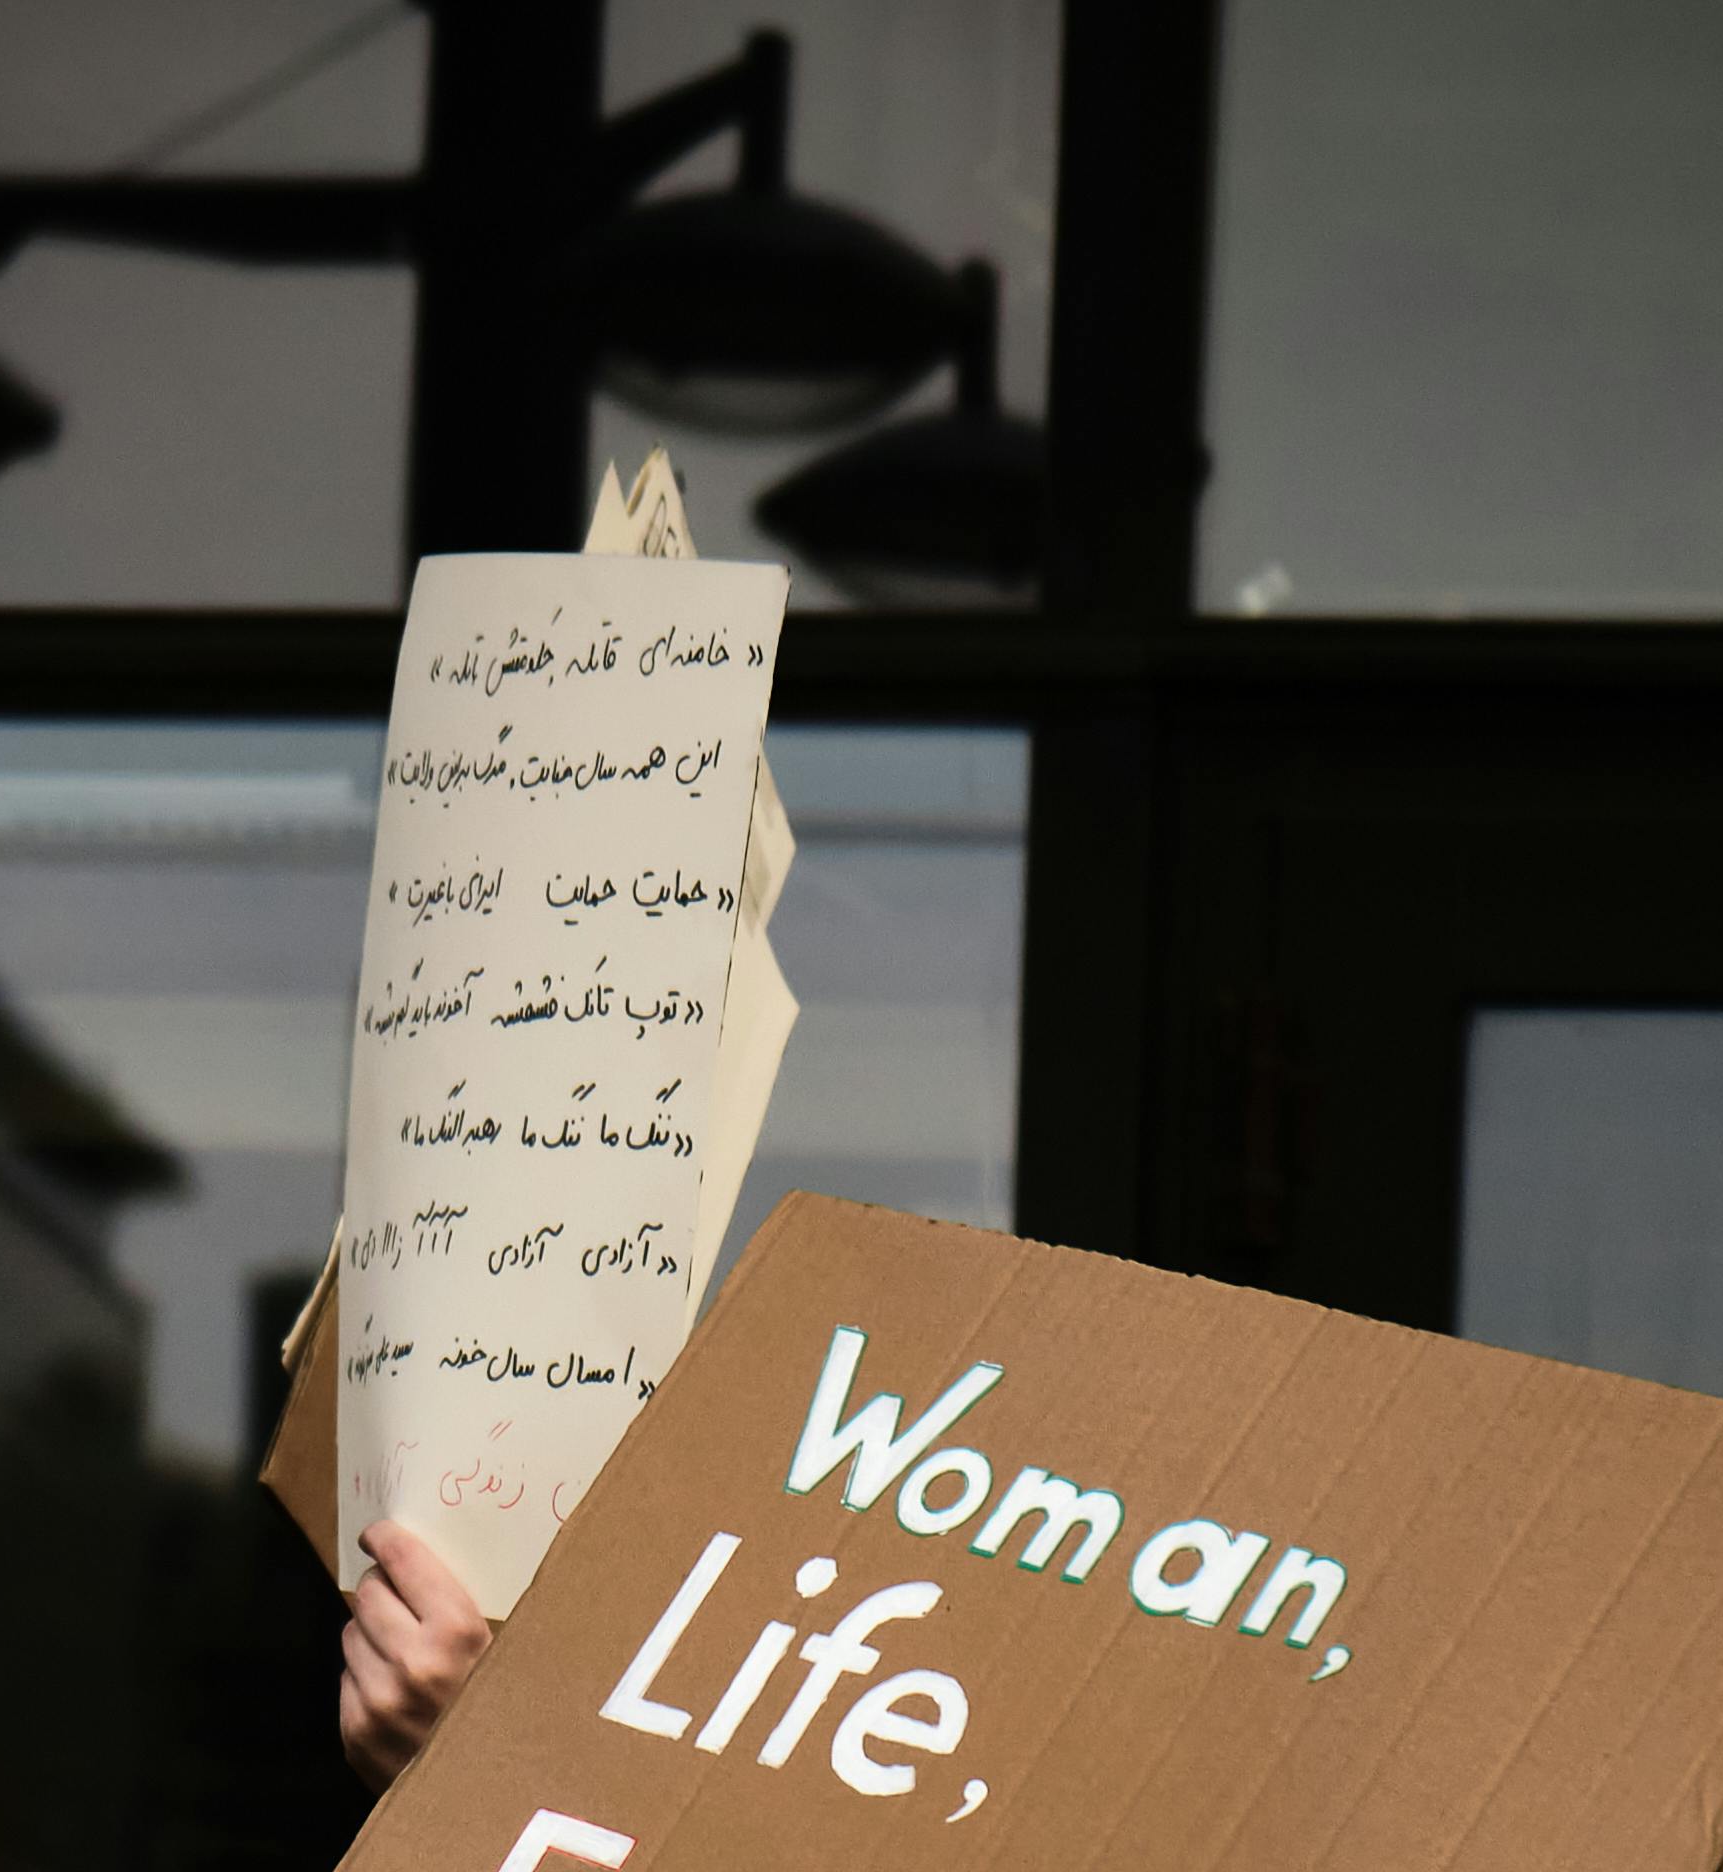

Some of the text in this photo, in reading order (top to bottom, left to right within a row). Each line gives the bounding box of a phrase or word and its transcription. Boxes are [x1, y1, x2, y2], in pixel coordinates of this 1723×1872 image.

[575, 751, 618, 791] سال
[620, 746, 667, 780] همه
[675, 739, 722, 799] این
[545, 873, 618, 927] حمایت
[489, 974, 565, 1029] فشفشه
[564, 955, 615, 1023] تانک
[461, 1116, 503, 1157] رهبر
[521, 1114, 537, 1149] ما
[541, 1082, 597, 1150] ننگ
[600, 1112, 620, 1148] ما
[487, 1222, 565, 1276] آزادی
[438, 1336, 488, 1370] خونه
[485, 1345, 536, 1383] سال
[783, 1324, 1352, 1682] Woman,
[599, 1531, 988, 1823] Life,
